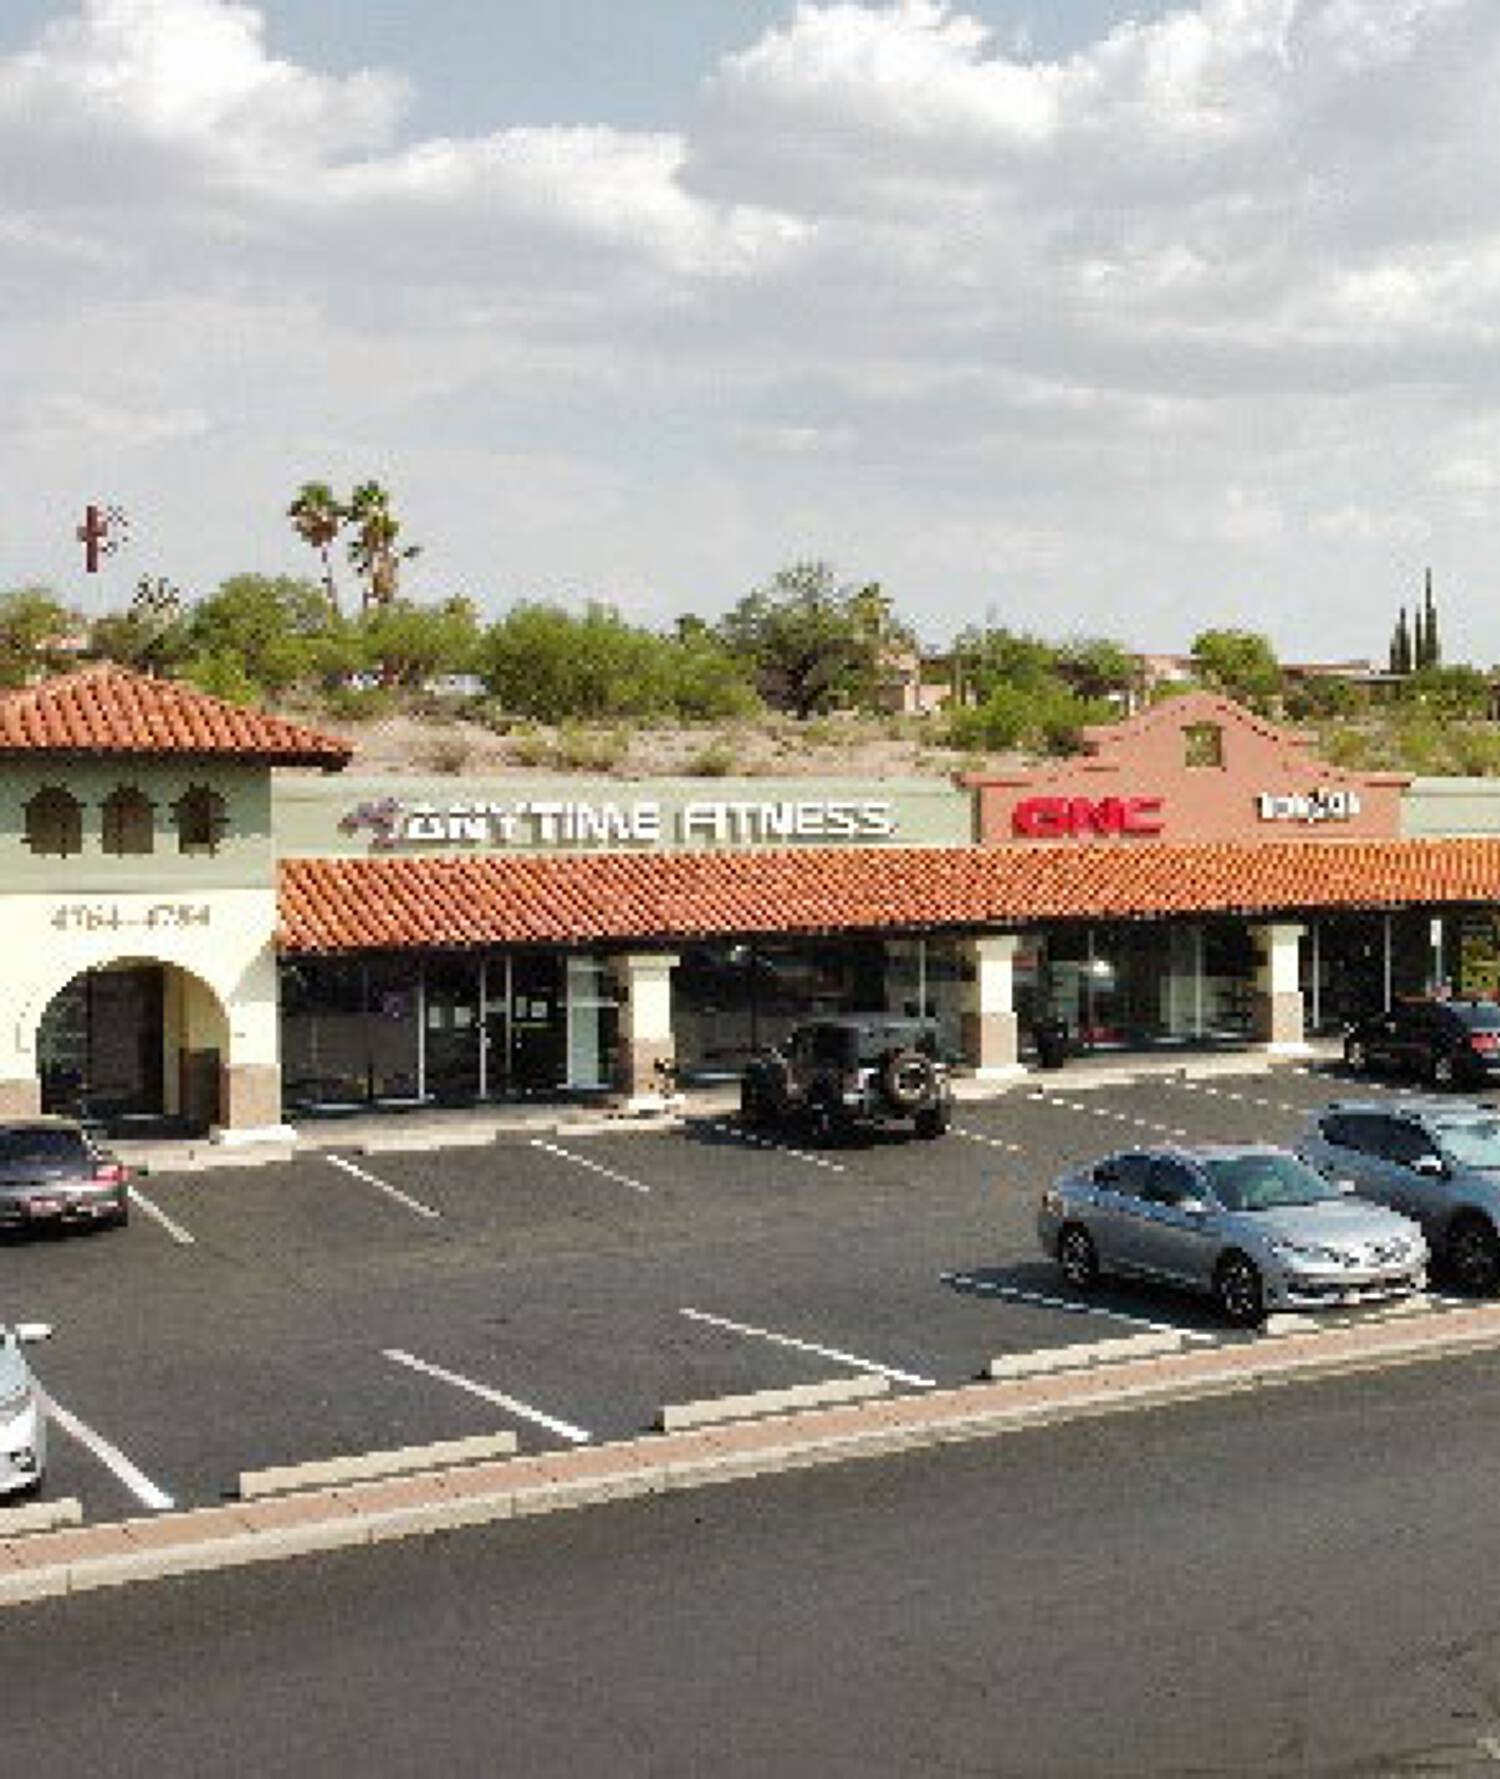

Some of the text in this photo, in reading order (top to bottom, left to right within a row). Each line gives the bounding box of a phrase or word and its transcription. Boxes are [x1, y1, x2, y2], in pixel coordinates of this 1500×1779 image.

[408, 802, 891, 840] ANYTIME FITNESS
[1012, 796, 1164, 837] GNC
